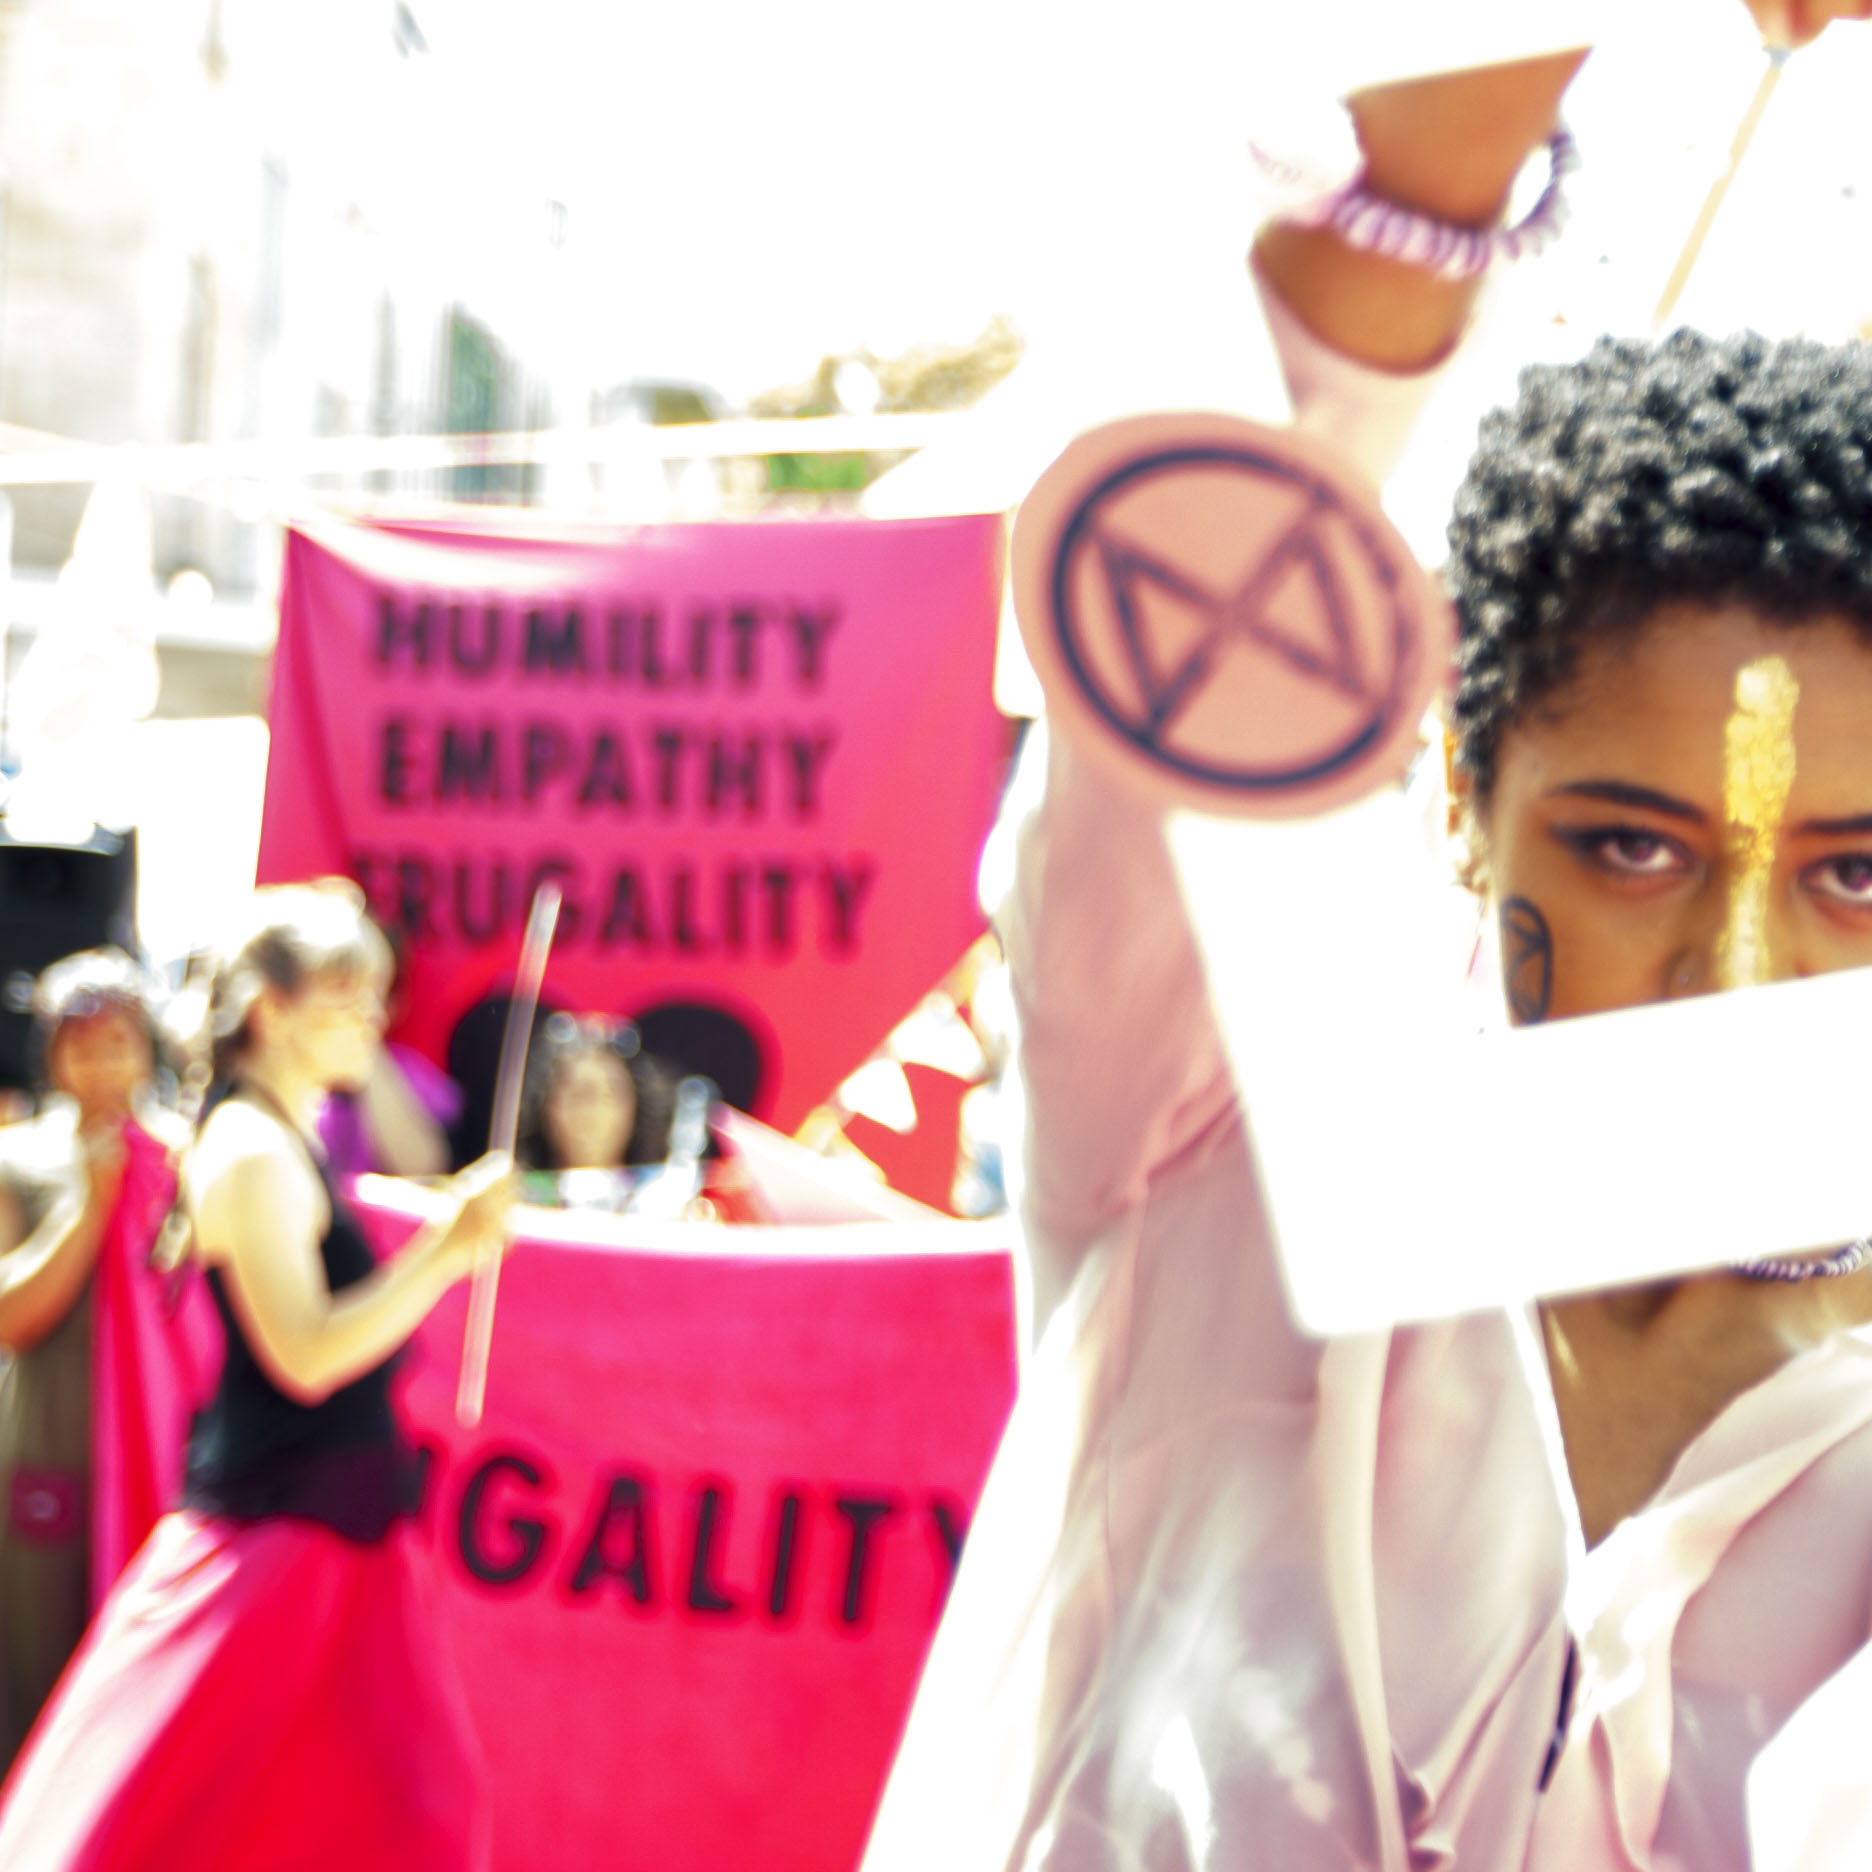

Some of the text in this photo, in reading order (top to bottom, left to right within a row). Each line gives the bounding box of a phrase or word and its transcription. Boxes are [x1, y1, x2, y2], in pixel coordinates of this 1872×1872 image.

[370, 594, 840, 690] HUMILITY
[377, 720, 836, 818] EMPATHY
[404, 1444, 964, 1624] GALIT
